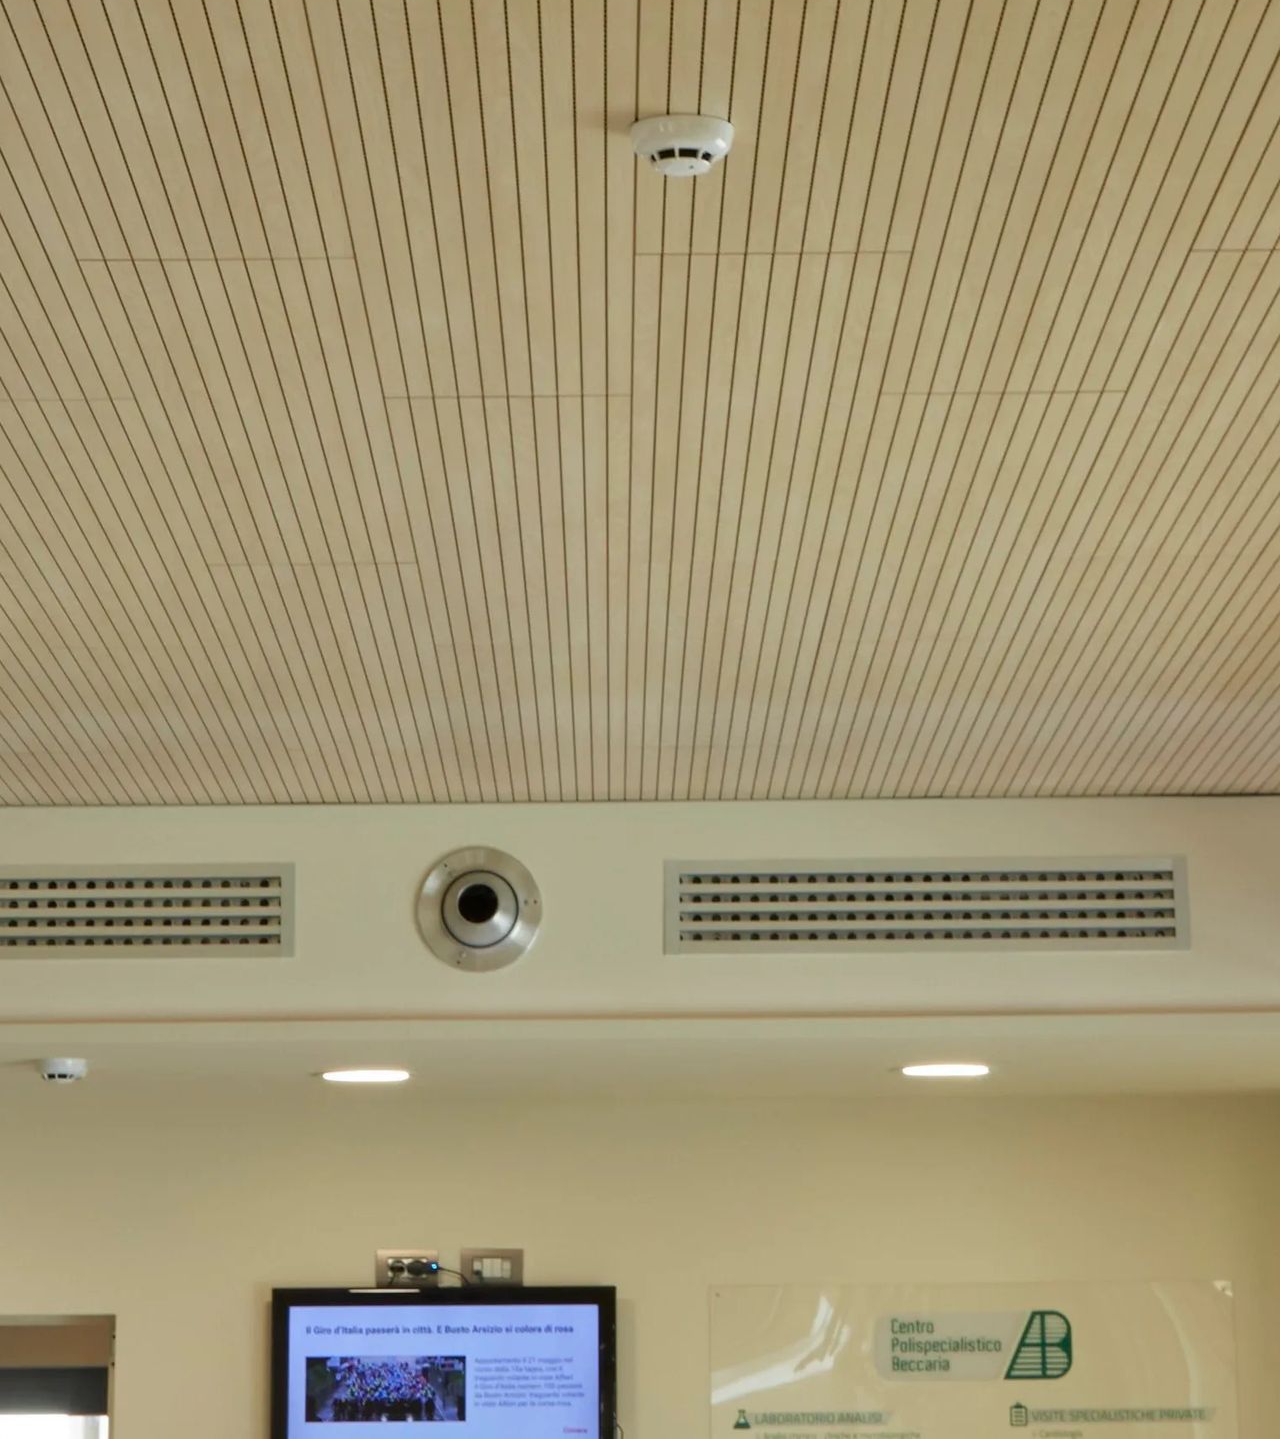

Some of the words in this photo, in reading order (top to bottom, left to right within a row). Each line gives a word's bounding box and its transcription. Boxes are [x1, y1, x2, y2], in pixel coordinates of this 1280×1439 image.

[305, 1325, 312, 1335] Il
[313, 1325, 332, 1335] Giro
[333, 1325, 363, 1335] d'Italia
[365, 1324, 401, 1337] passerà
[402, 1325, 411, 1335] in
[444, 1324, 470, 1334] Busto
[472, 1324, 504, 1334] Arsizio
[543, 1324, 553, 1334] di
[890, 1318, 935, 1335] Centro
[891, 1337, 1003, 1356] Polispecialistico
[891, 1356, 951, 1373] Beccaria
[753, 1412, 836, 1426] LABORATORIO
[837, 1411, 884, 1425] ANALISI
[1031, 1409, 1066, 1422] VISITE
[1070, 1409, 1156, 1422] SPECIALISTICHE
[1159, 1408, 1207, 1421] PRIVATE
